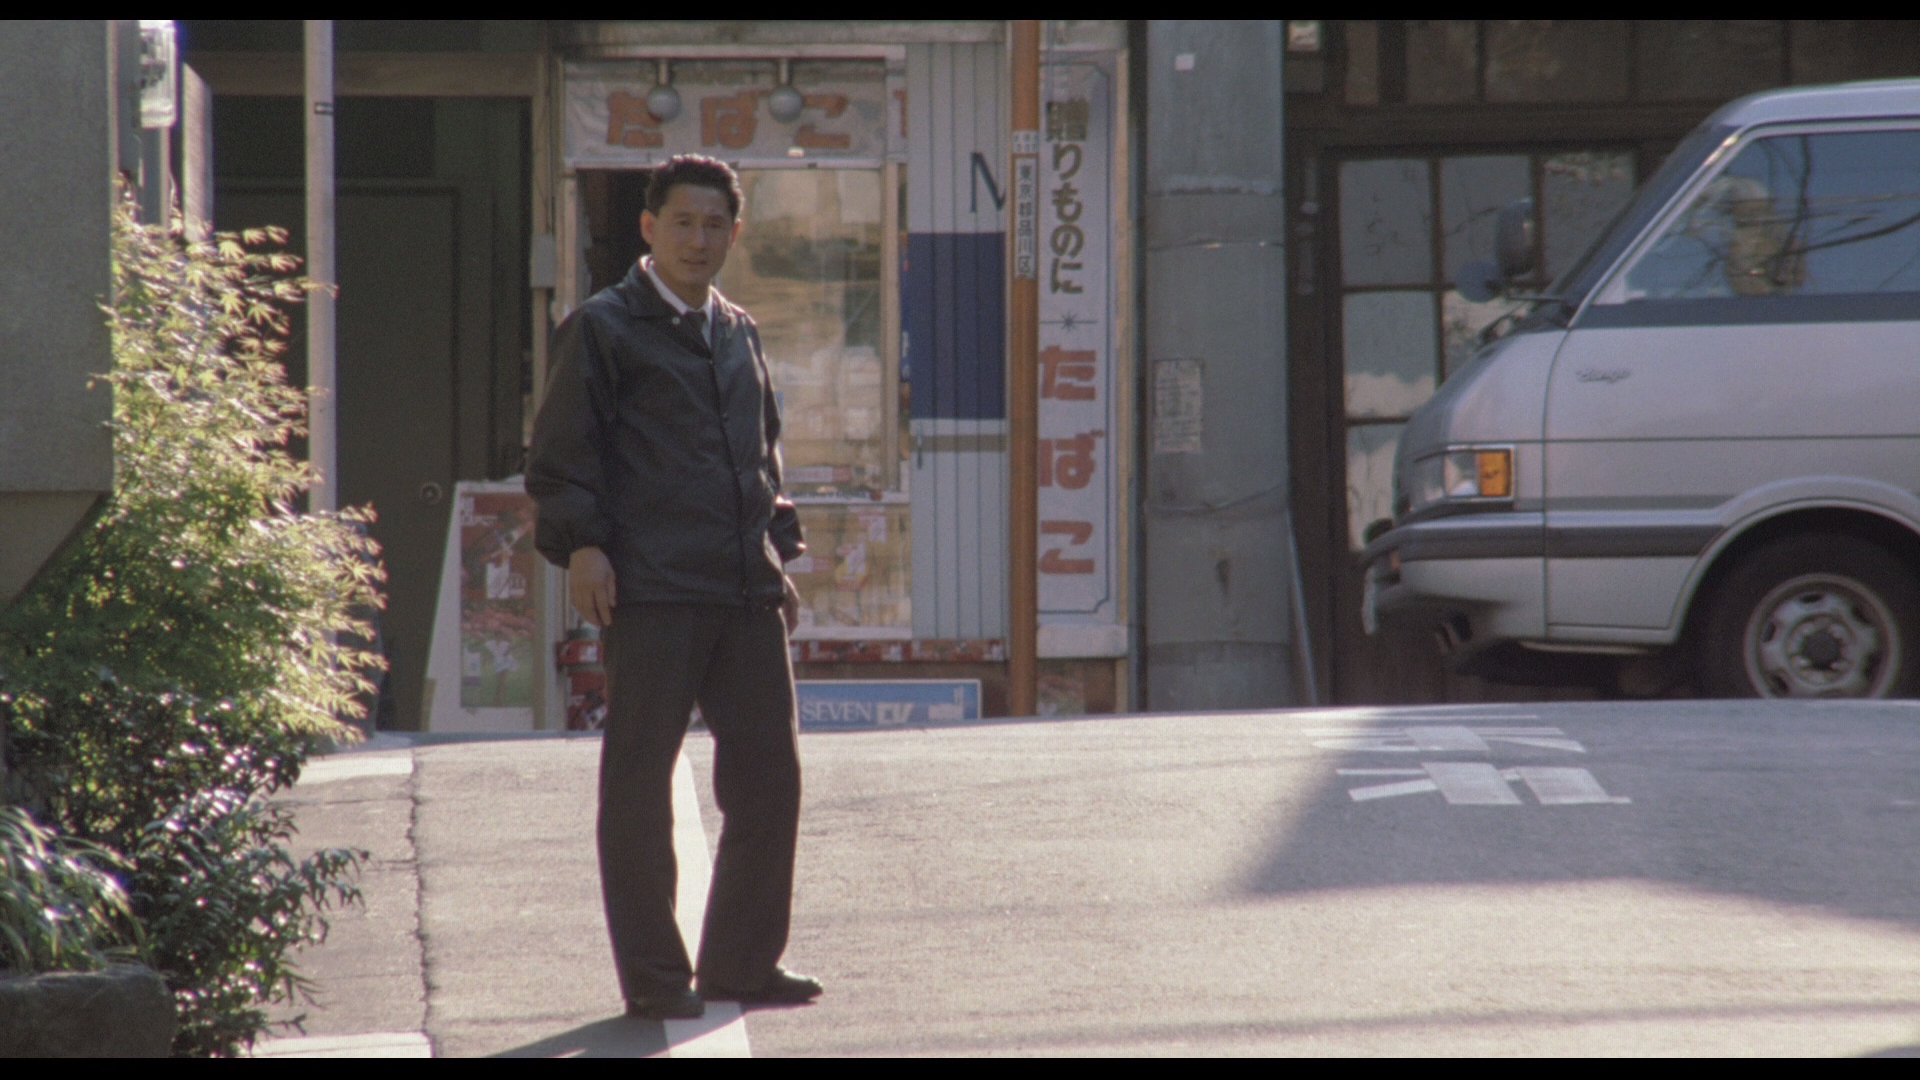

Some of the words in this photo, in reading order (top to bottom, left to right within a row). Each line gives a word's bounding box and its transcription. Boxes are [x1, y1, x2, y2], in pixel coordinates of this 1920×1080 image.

[605, 88, 851, 148] たばこ
[1017, 164, 1034, 274] 東京都品川区
[1045, 98, 1090, 295] 贈りものに
[1038, 345, 1104, 575] たばこ
[800, 701, 873, 723] SEVEN
